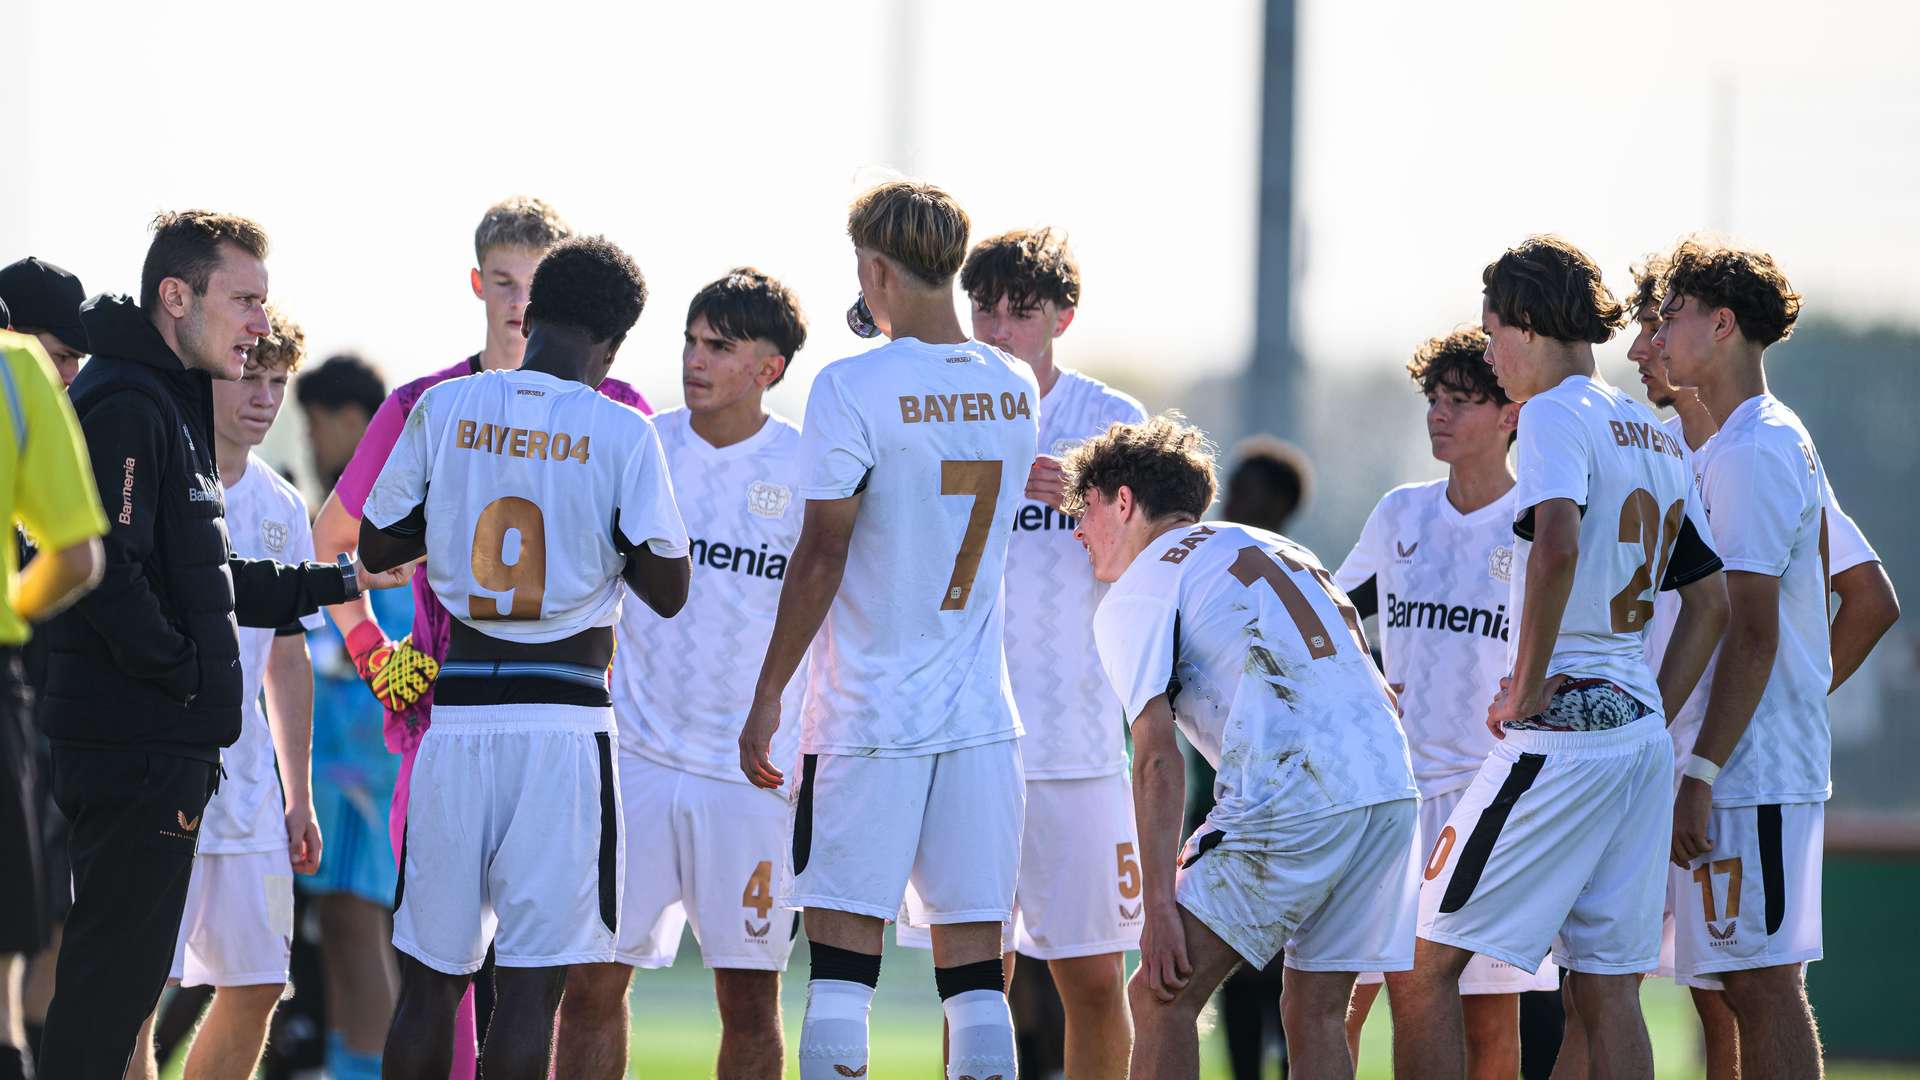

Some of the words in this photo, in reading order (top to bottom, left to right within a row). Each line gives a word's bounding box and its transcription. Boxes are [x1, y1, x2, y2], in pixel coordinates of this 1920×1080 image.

[899, 393, 996, 423] BAYER
[1001, 392, 1030, 420] 04
[456, 419, 549, 460] BAYER
[551, 432, 590, 464] 04
[119, 457, 136, 525] Barmenia
[468, 496, 546, 621] 9
[689, 537, 788, 580] menia
[940, 460, 1003, 611] 7
[1160, 525, 1217, 565] BAY
[1116, 841, 1141, 899] 5
[1424, 825, 1457, 881] 0
[742, 861, 773, 919] 4
[1693, 857, 1743, 922] 17
